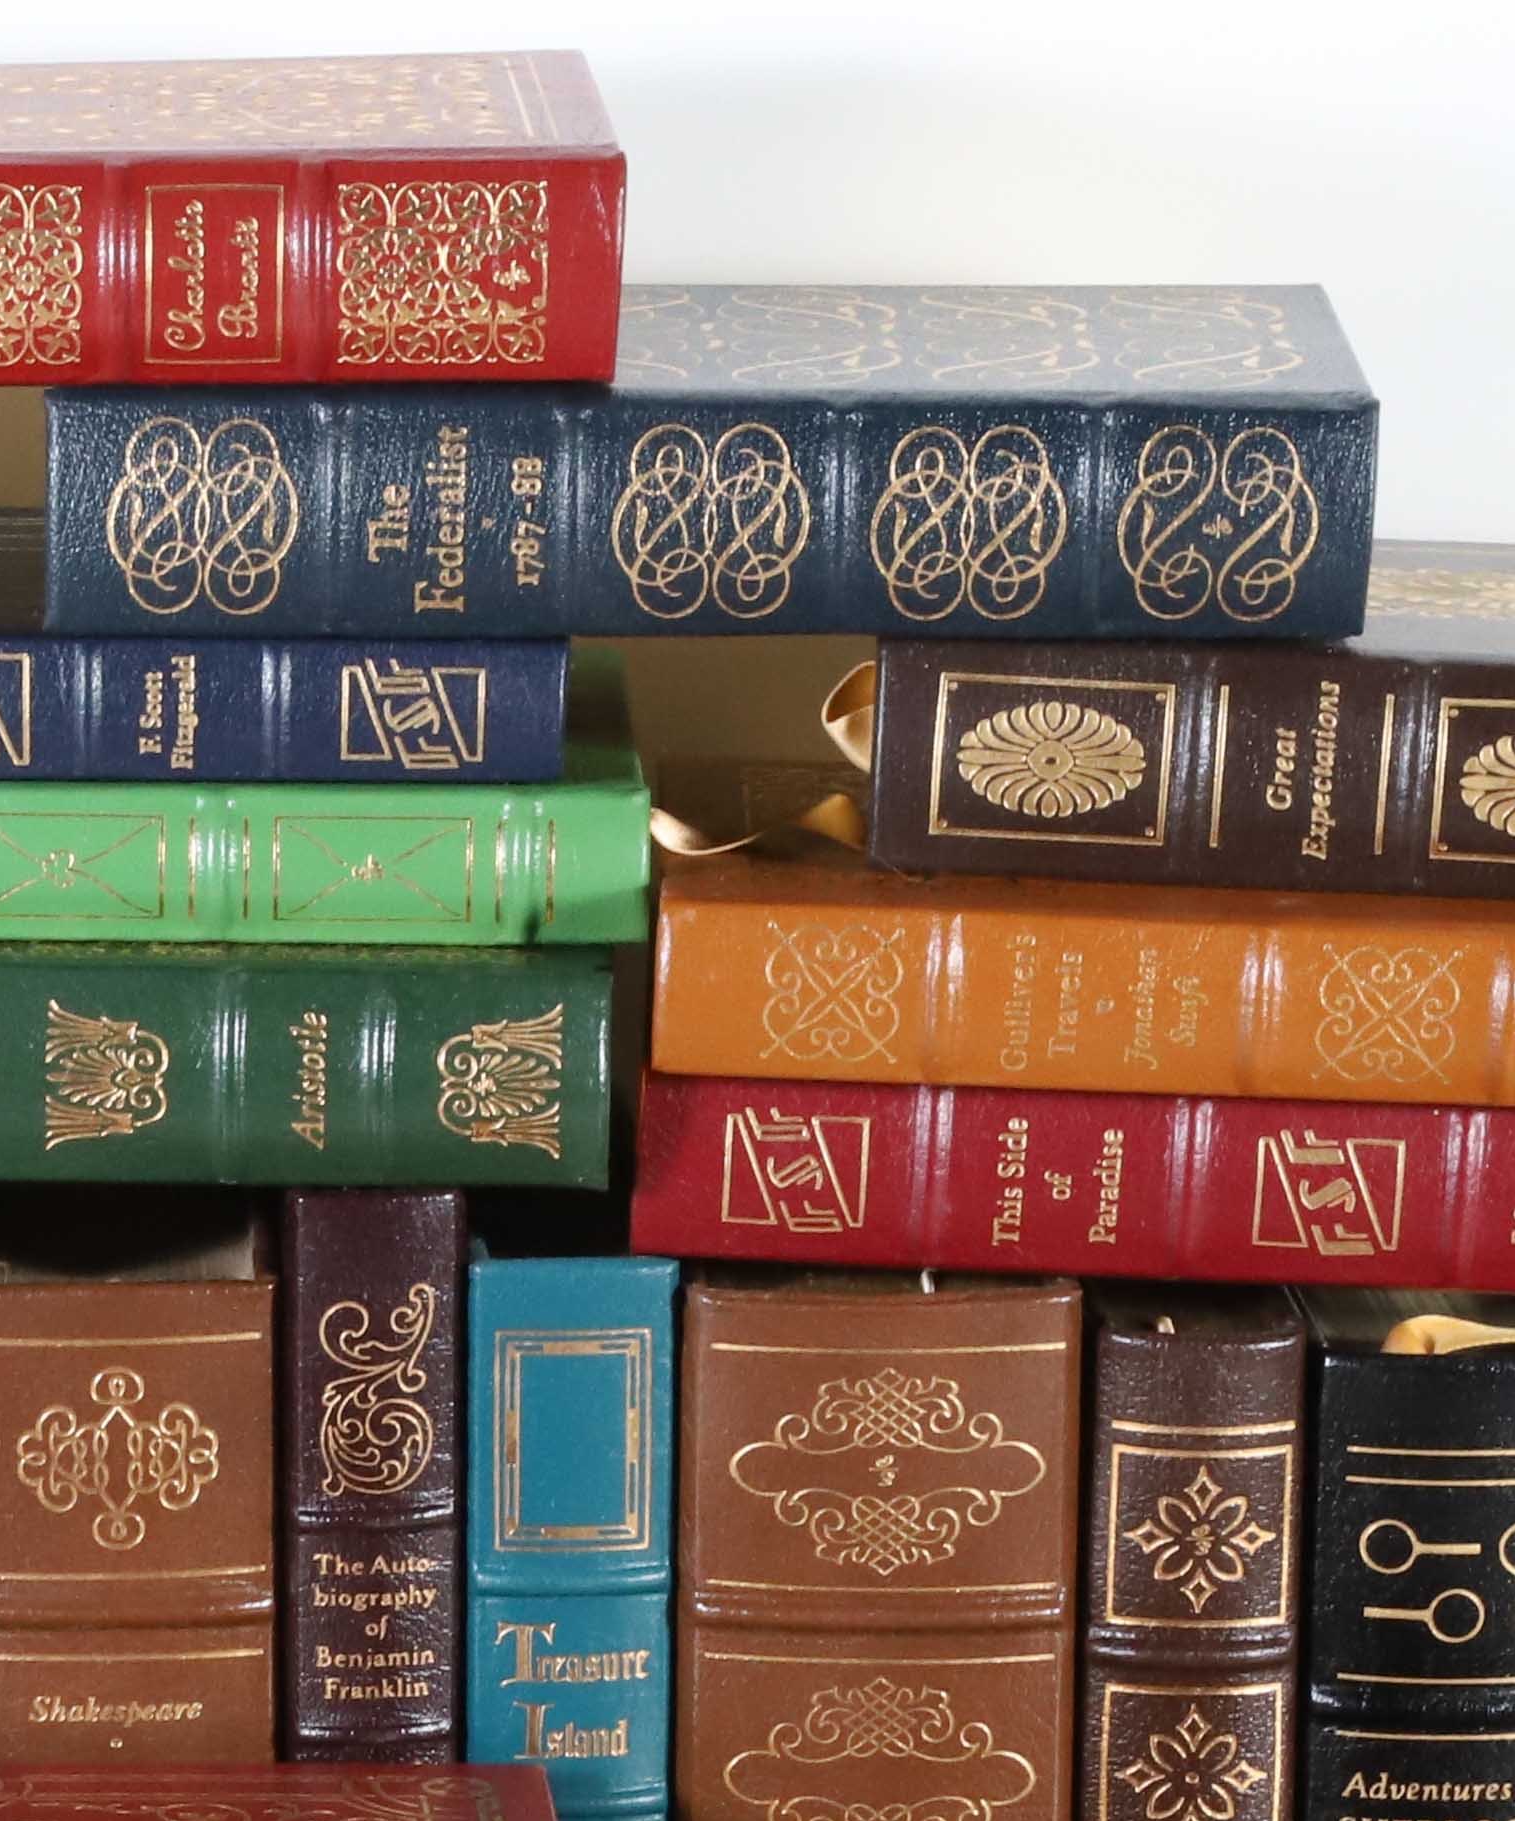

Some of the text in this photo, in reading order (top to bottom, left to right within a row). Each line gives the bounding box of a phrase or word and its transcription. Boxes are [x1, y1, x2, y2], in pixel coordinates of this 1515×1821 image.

[163, 198, 206, 351] Charlotte
[368, 482, 411, 564] The
[414, 424, 469, 615] Federalist
[170, 653, 200, 770] Fitzgerald
[1265, 726, 1298, 812] Great
[1301, 679, 1341, 860] Expectations
[290, 1010, 328, 1151] Aristotle
[991, 1116, 1029, 1247] This Side
[1089, 1127, 1125, 1245] Paradise
[311, 1584, 439, 1614] biography
[314, 1646, 437, 1674] Benjamin
[323, 1676, 430, 1703] Franklin
[495, 1620, 652, 1690] Treasure
[27, 1694, 205, 1726] Shakespeare
[512, 1700, 630, 1760] Island
[1341, 1770, 1515, 1804] Adventures
